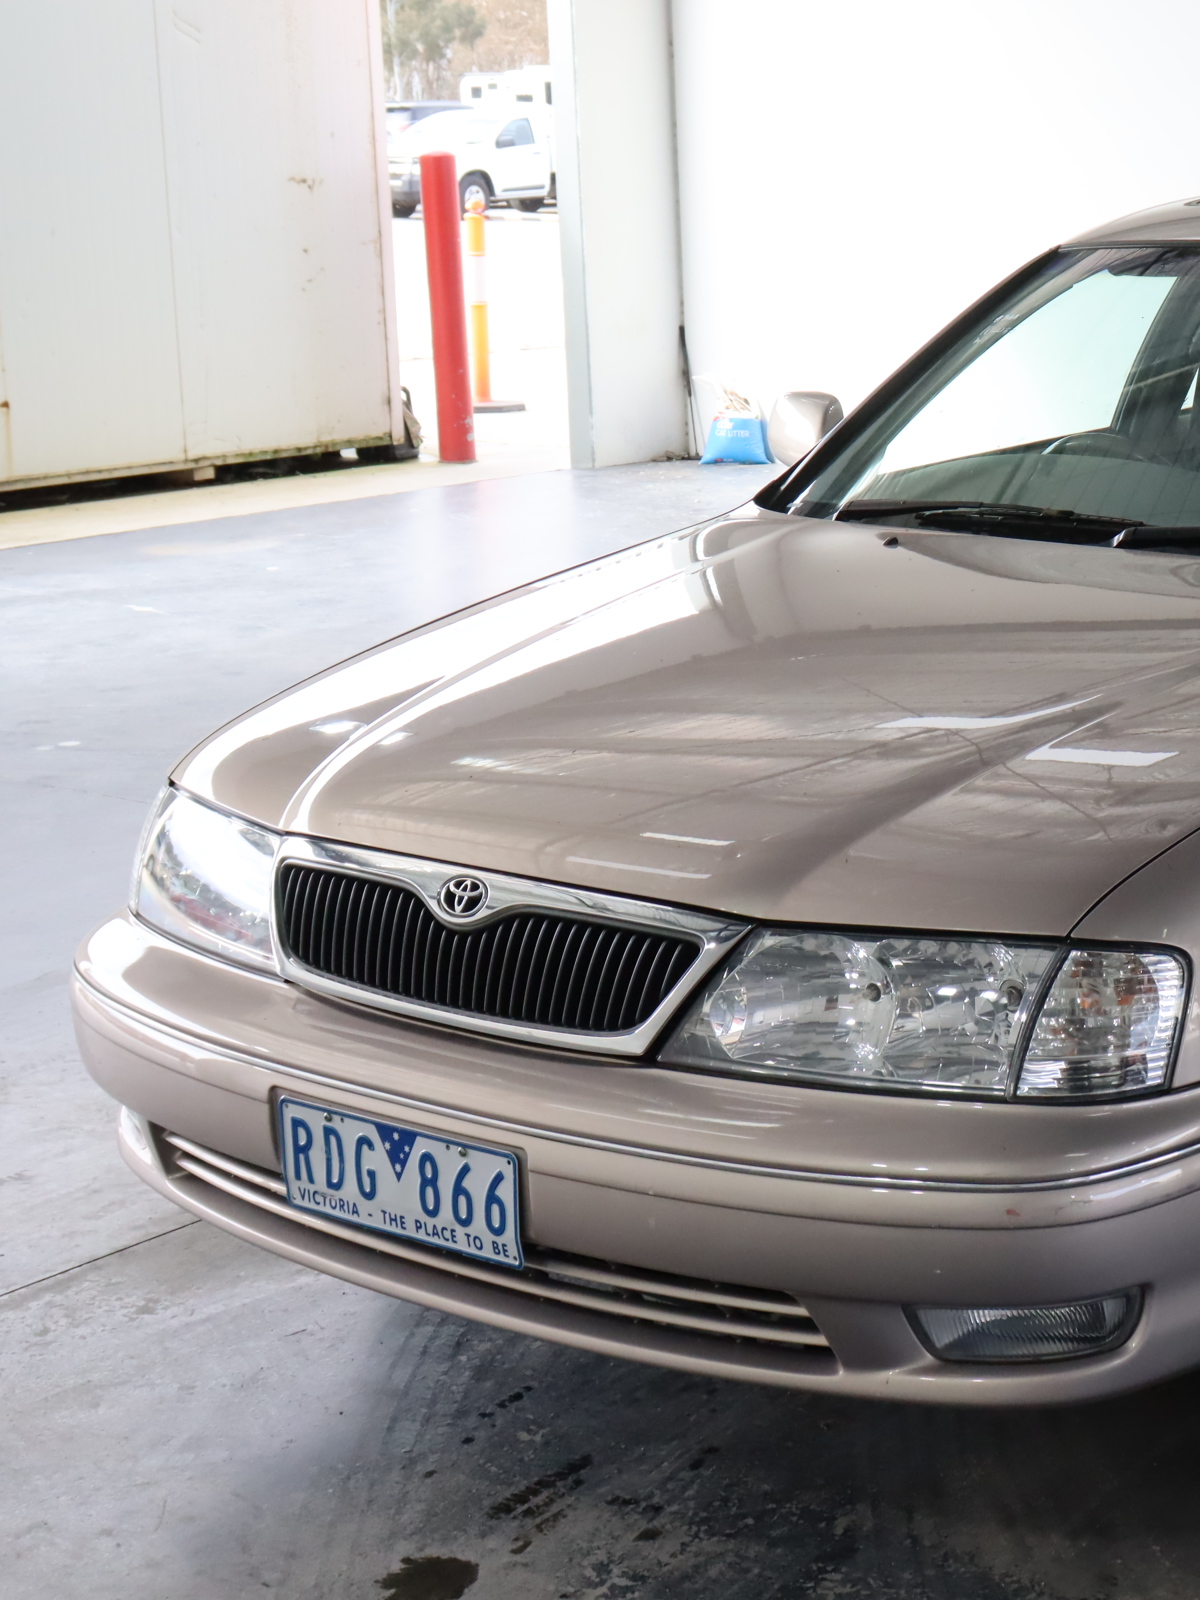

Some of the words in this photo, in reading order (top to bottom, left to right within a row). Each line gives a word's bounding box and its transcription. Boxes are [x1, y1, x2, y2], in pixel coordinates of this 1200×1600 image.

[727, 429, 750, 438] LITTER
[290, 1116, 377, 1201] RDG
[418, 1149, 507, 1237] 866
[298, 1186, 360, 1218] VICTORIA
[380, 1209, 407, 1230] THE
[414, 1219, 458, 1244] PLACE
[464, 1233, 484, 1251] TO
[491, 1241, 510, 1258] BE
